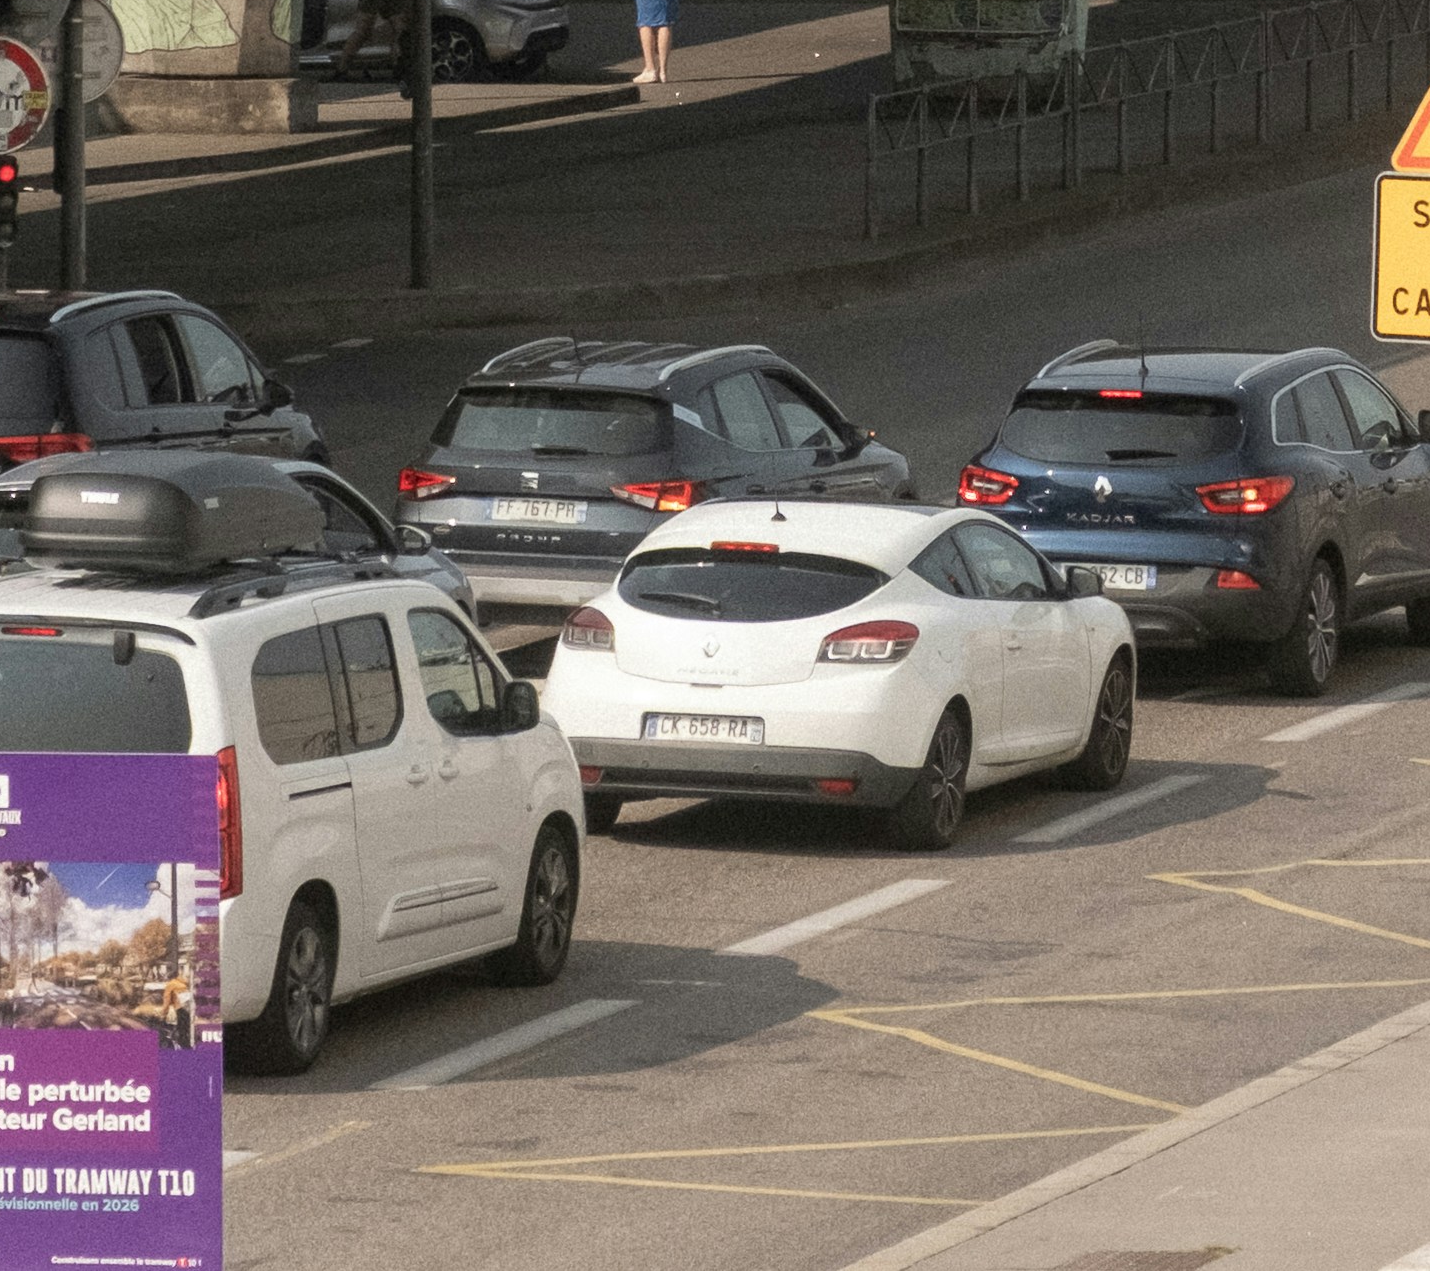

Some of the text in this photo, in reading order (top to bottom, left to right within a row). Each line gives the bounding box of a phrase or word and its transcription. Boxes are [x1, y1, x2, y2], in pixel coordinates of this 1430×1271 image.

[1066, 512, 1136, 525] KADJAR
[660, 715, 748, 738] CK-658-RA
[27, 1077, 152, 1107] perturbée
[52, 1107, 151, 1132] Gerland
[22, 1168, 48, 1195] DU
[54, 1168, 153, 1196] TRAMWAY
[158, 1169, 195, 1197] T10
[81, 1200, 99, 1211] en
[102, 1198, 140, 1212] 2026
[100, 1257, 134, 1266] ensemble
[145, 1257, 176, 1268] tramway
